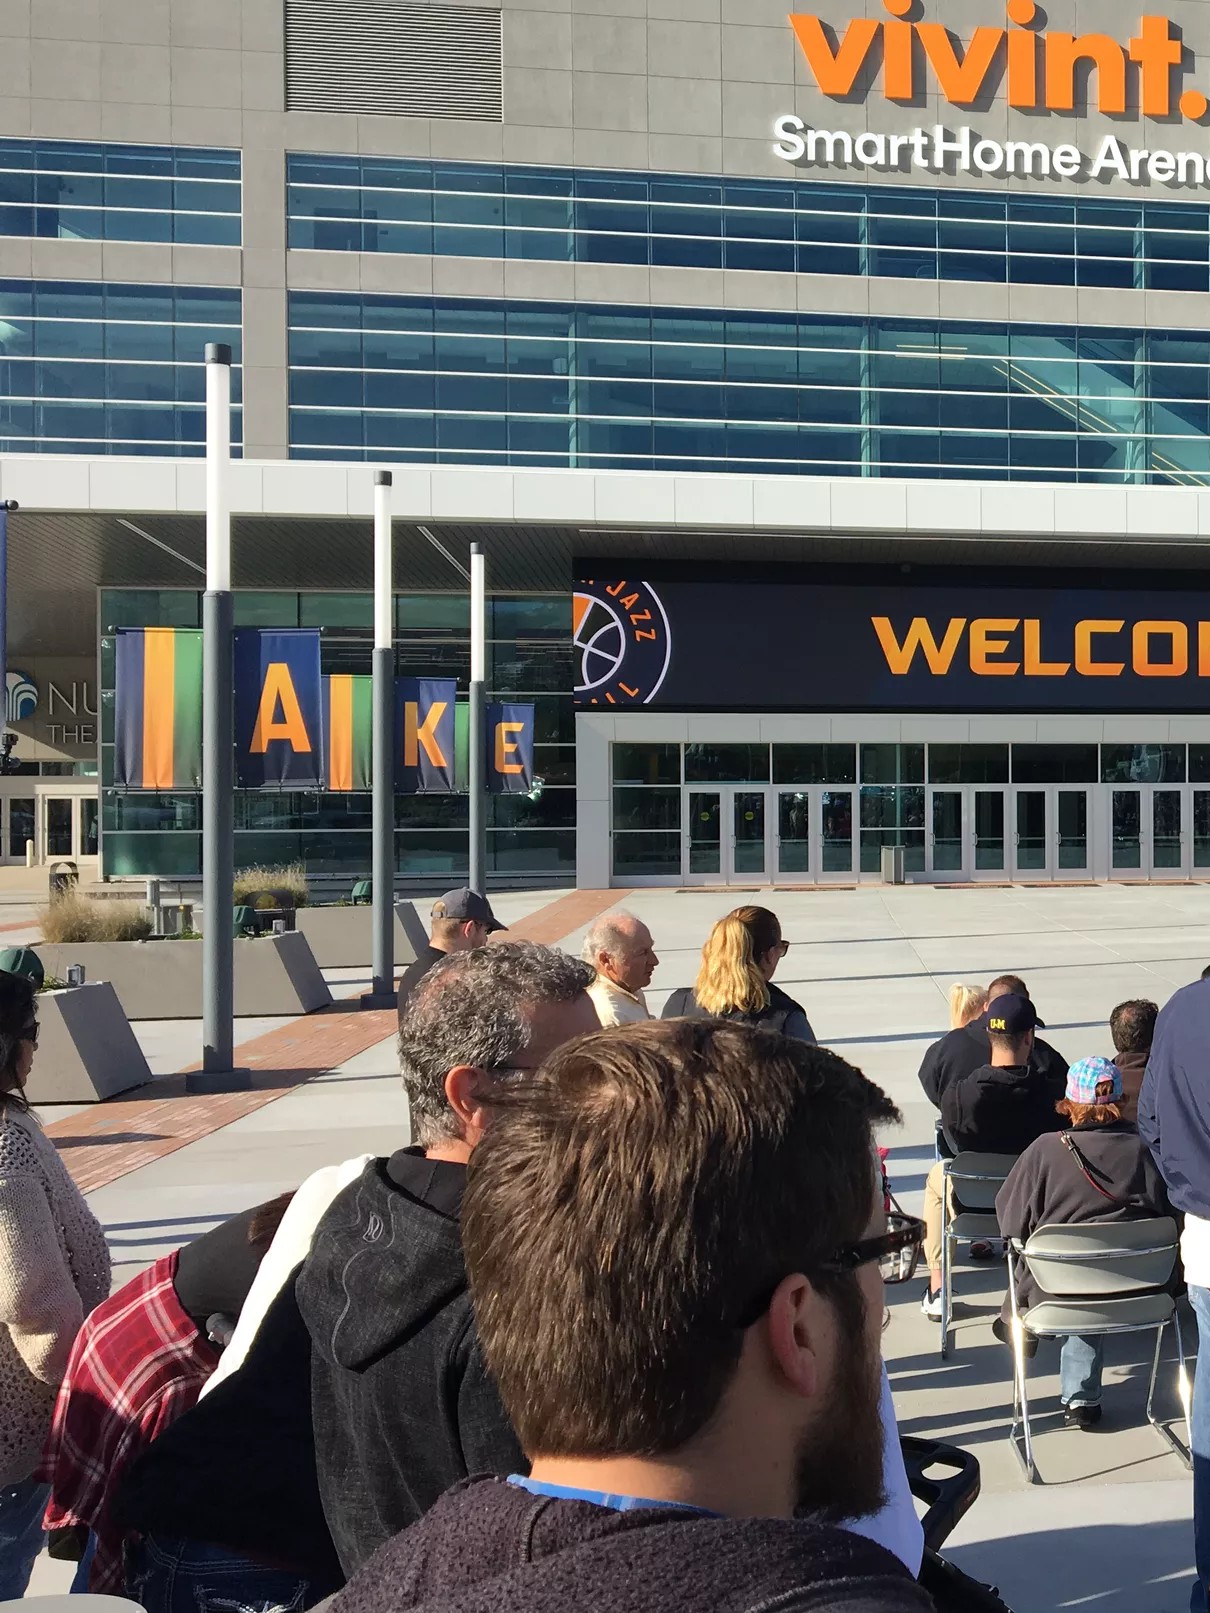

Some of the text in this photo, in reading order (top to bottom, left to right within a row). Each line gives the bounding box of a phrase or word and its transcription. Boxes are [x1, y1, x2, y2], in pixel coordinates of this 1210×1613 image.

[788, 0, 1208, 120] vivint.
[605, 580, 656, 642] JAZZ
[249, 662, 312, 753] A
[404, 701, 448, 767] K
[494, 722, 525, 773] E
